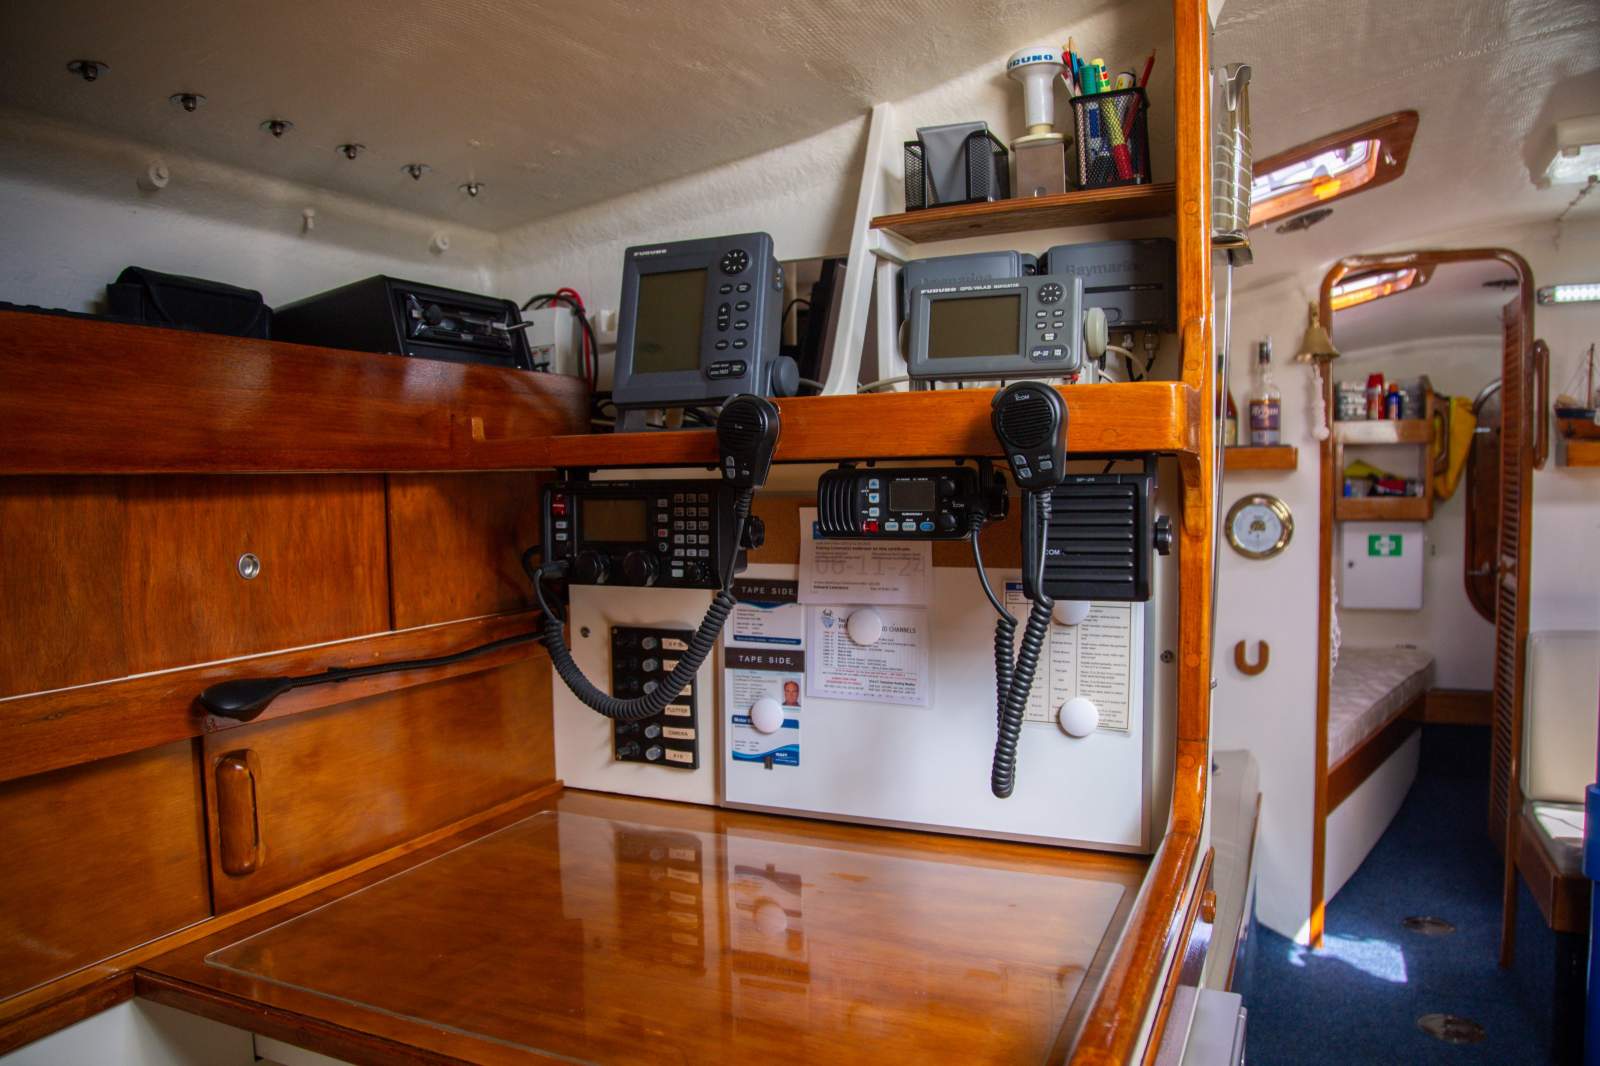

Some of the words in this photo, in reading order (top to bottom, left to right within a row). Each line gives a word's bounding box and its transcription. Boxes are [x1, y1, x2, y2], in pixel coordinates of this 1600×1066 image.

[741, 585, 765, 594] TAPE
[771, 587, 794, 596] SIDE
[738, 655, 763, 664] TAPE
[768, 656, 791, 666] SIDE
